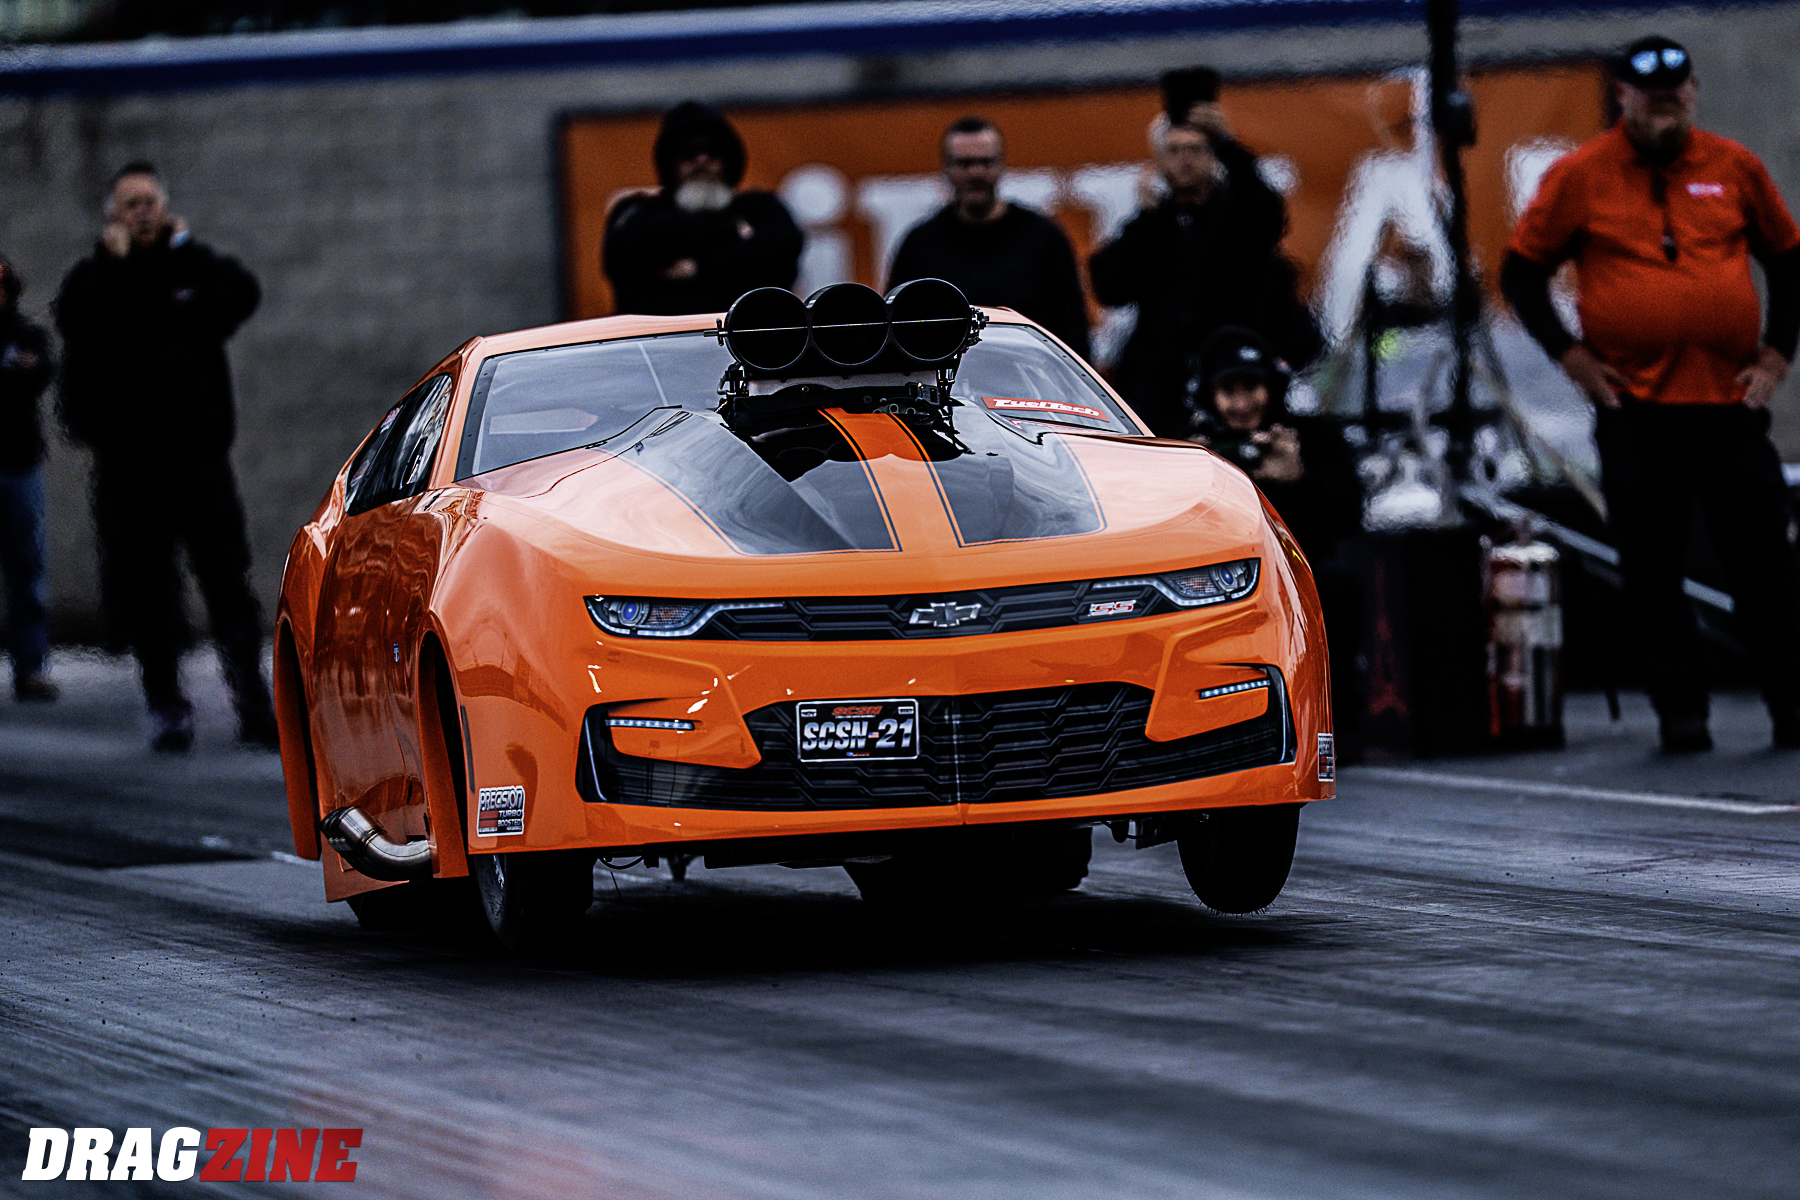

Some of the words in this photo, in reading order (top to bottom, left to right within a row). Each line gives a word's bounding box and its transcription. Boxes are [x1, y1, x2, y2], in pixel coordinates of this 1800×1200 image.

[993, 398, 1100, 416] FuelTech
[832, 706, 882, 716] SCSN
[498, 809, 522, 818] TURBO
